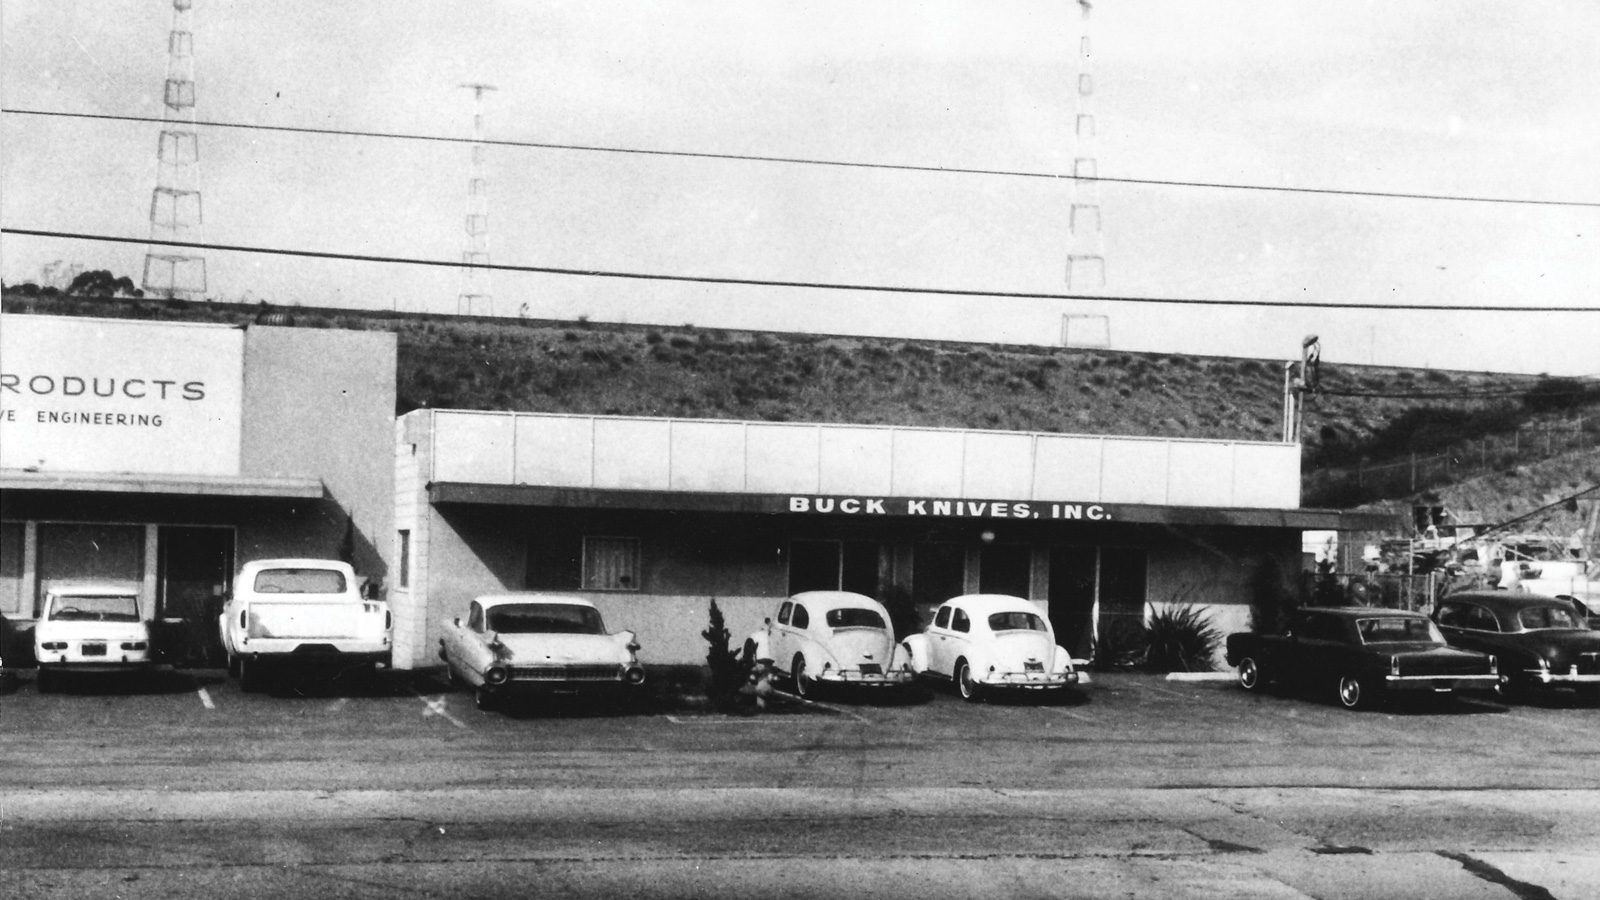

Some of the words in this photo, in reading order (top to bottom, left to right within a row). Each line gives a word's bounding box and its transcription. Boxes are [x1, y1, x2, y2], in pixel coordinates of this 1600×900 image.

[37, 411, 162, 427] ENGINEERING
[788, 496, 886, 514] BUCK
[907, 500, 1039, 519] KNIVES,
[1052, 504, 1112, 520] INC.
